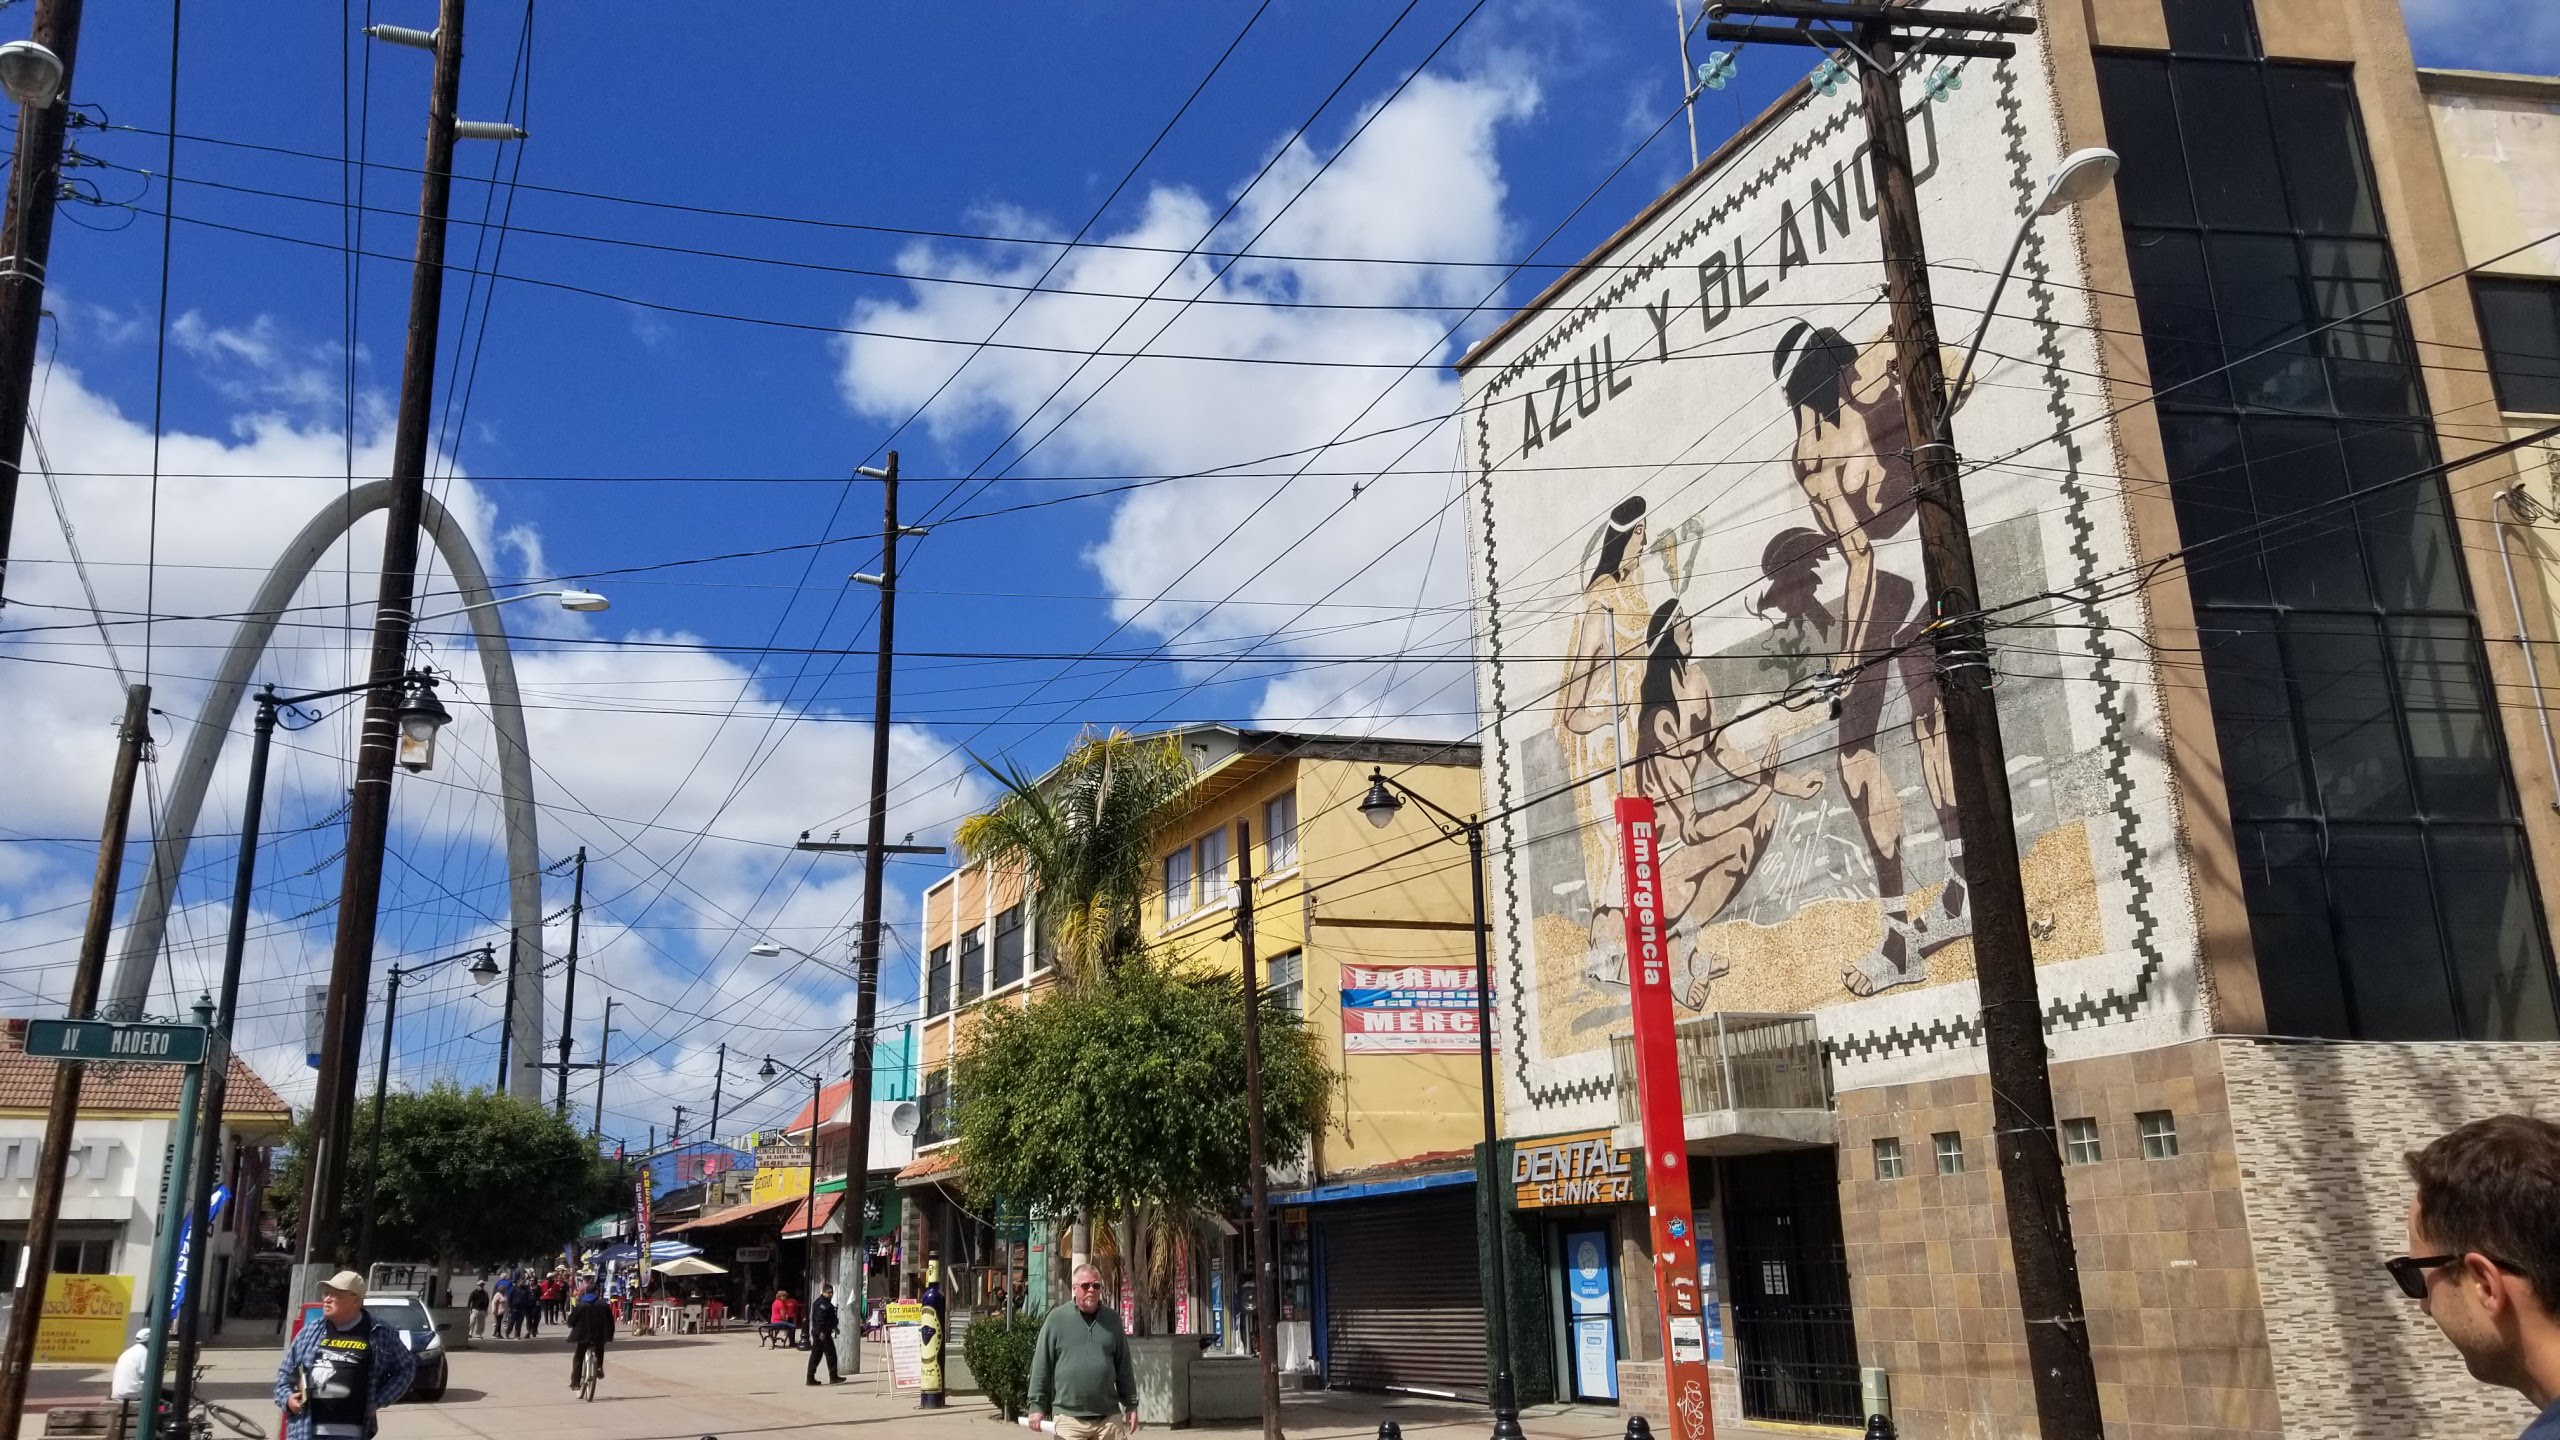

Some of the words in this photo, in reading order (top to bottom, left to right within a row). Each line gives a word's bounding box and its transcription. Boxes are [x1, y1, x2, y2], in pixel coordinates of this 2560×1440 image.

[1522, 335, 1632, 460] AZUL
[1645, 288, 1670, 364] Y
[1632, 821, 1663, 986] Emergencia
[1354, 968, 1498, 989] FARMA
[1363, 1011, 1499, 1032] MERC
[61, 1027, 80, 1052] AV.
[110, 1029, 170, 1056] MADERO
[1511, 1138, 1628, 1184] DENTAL
[1539, 1179, 1600, 1203] CLINIK
[1611, 1177, 1630, 1199] TJ
[635, 1182, 646, 1252] BEBIDAS
[328, 1339, 367, 1350] SMITHS
